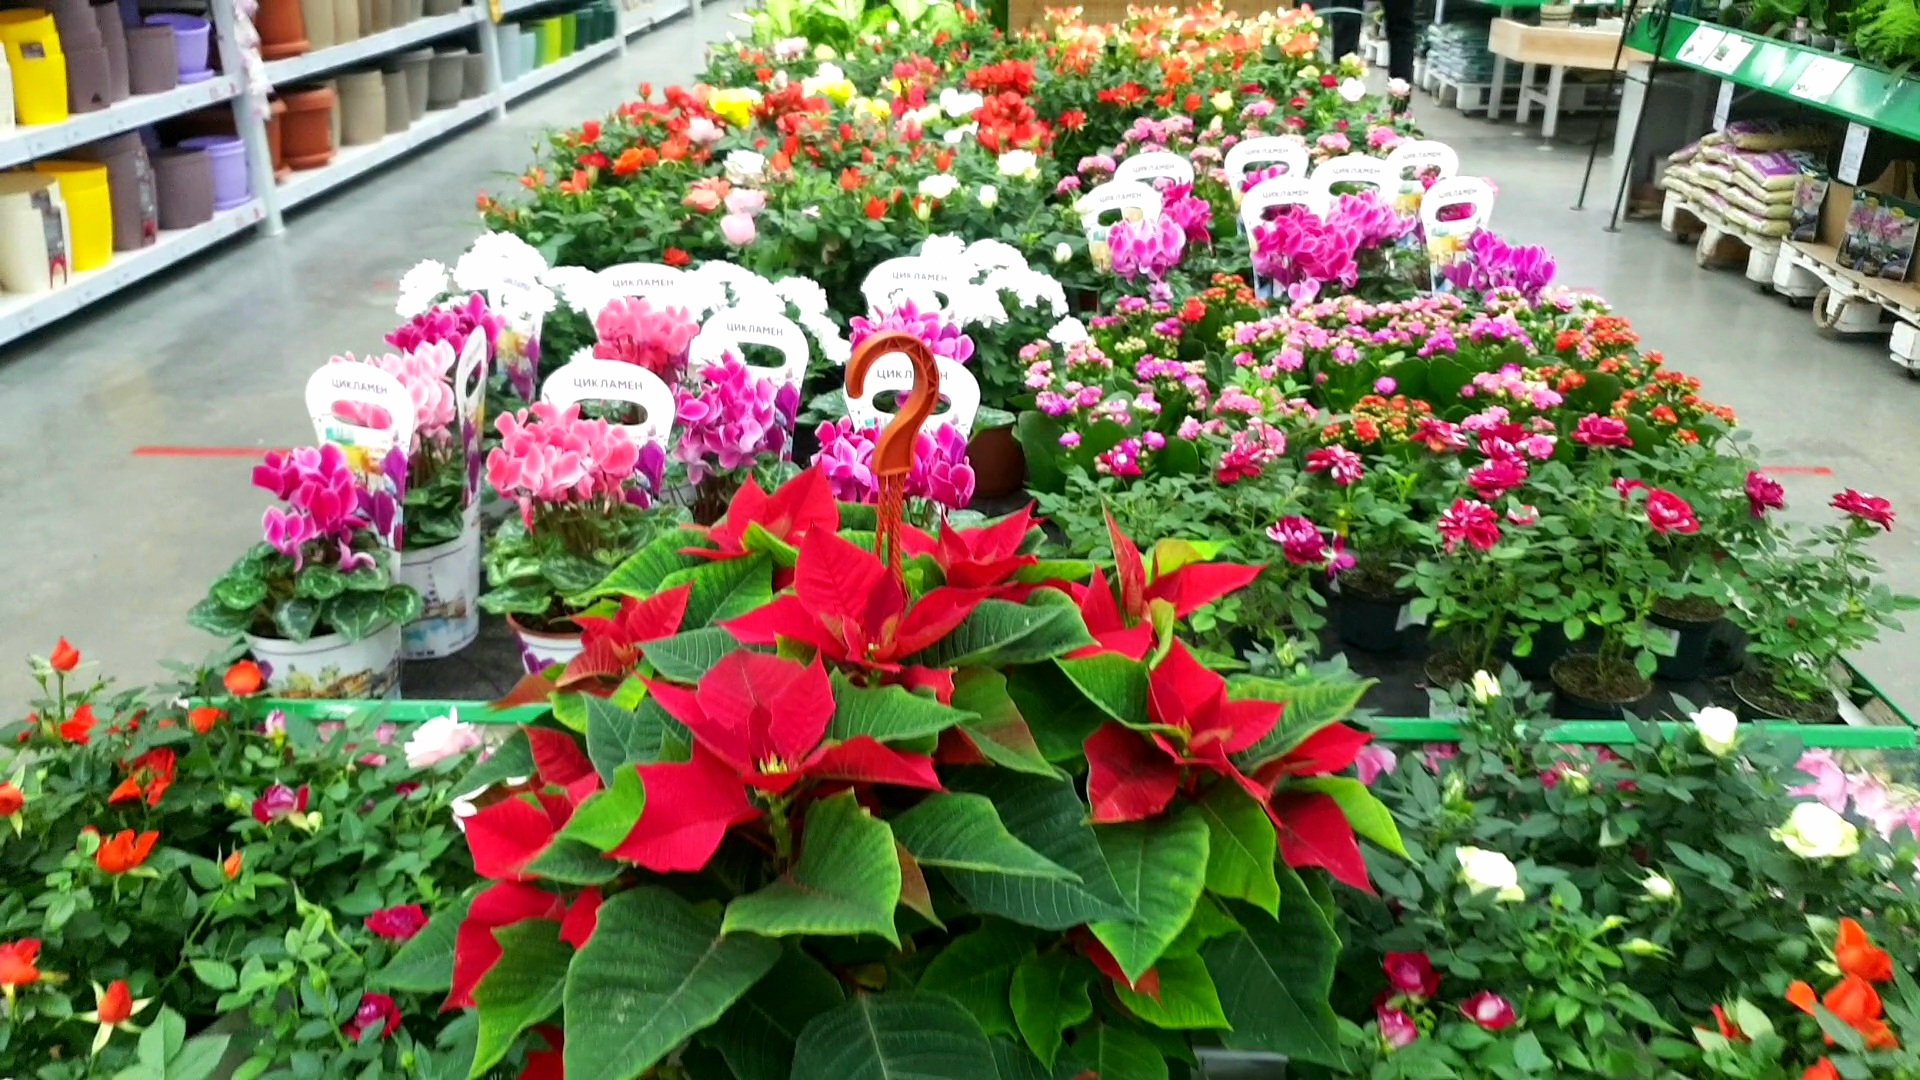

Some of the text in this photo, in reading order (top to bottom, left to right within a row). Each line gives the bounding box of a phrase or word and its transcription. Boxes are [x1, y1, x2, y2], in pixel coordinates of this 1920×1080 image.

[892, 270, 948, 282] ЦИКЛАМЕН
[612, 278, 674, 288] ЦИКЛАМЕН
[726, 322, 784, 336] ЦИКЛАМЕН
[876, 369, 948, 380] ЦИКЛН
[331, 378, 388, 395] ЦИКЛАМЕН
[573, 377, 643, 391] ЦИКЛАМЕН
